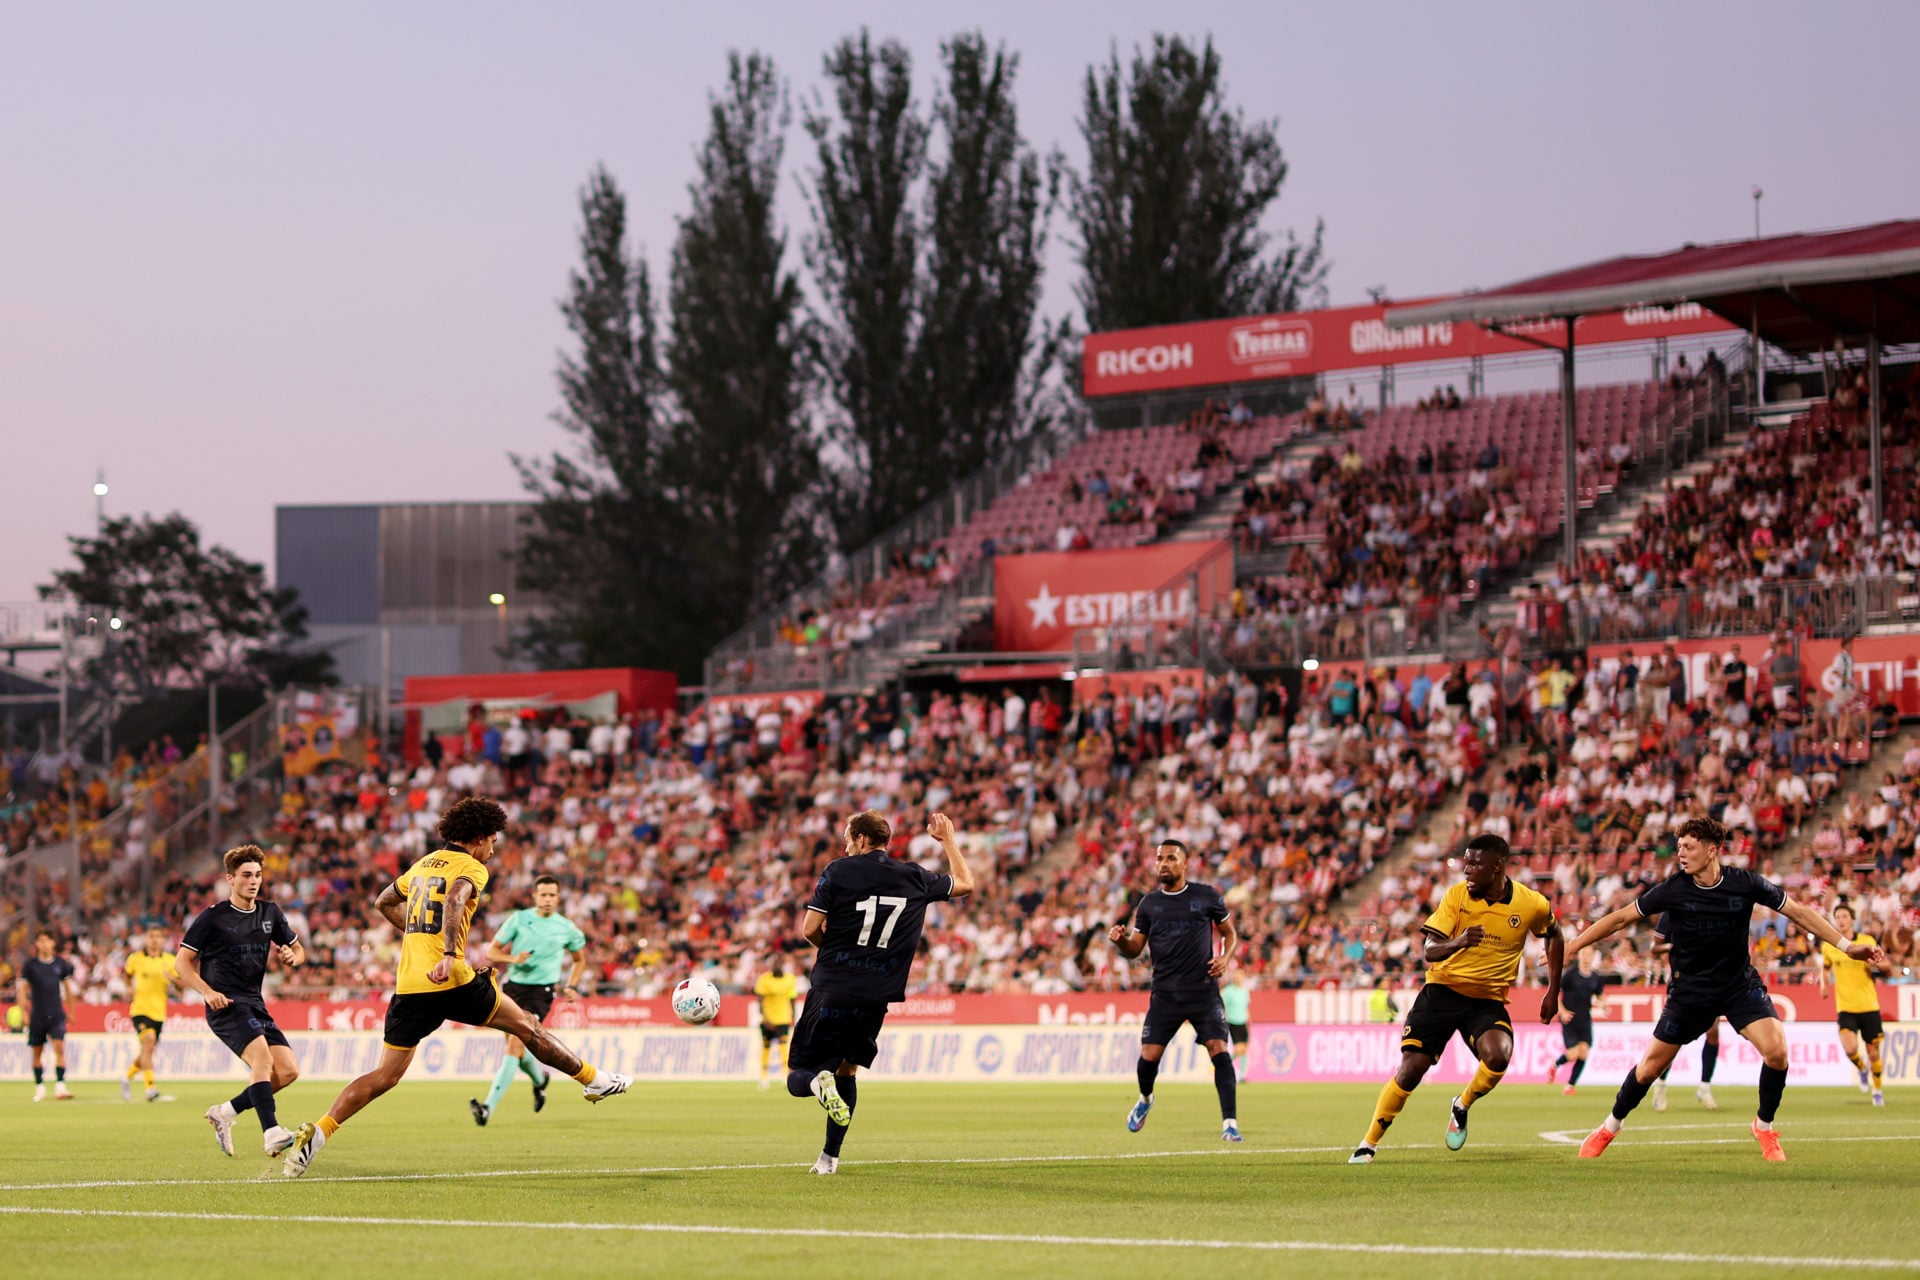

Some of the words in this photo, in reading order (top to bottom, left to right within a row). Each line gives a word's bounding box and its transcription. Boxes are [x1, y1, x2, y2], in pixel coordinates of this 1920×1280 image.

[1096, 342, 1194, 377] RICOH
[406, 876, 447, 935] 26
[855, 895, 908, 949] 17
[1038, 1002, 1148, 1024] Marle
[1737, 1043, 1840, 1064] ESELLA
